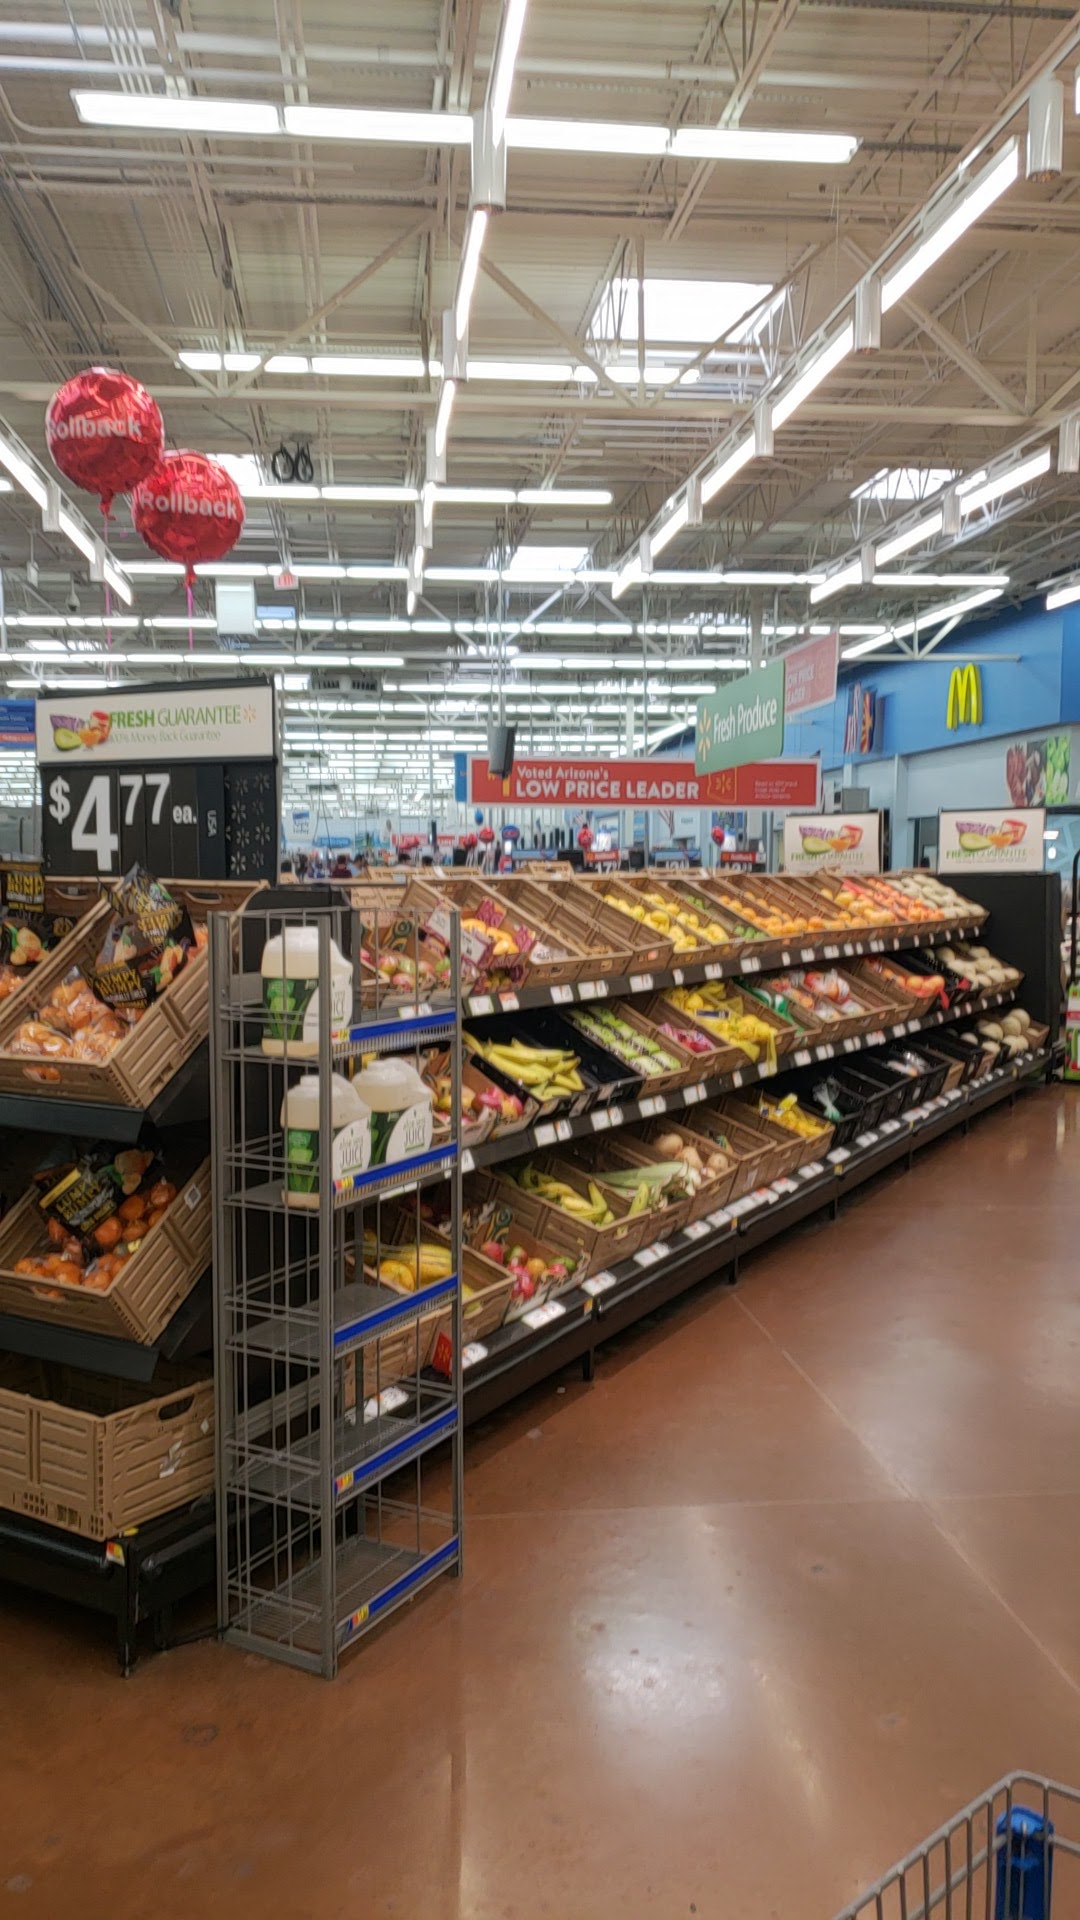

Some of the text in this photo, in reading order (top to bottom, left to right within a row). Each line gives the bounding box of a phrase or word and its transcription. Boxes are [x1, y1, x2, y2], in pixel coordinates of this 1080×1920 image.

[139, 490, 238, 520] Rollback
[109, 704, 241, 729] FRESH GUARANTEE
[713, 694, 778, 744] Fresh Produce
[517, 765, 609, 780] Voted Arizona's
[516, 780, 699, 799] LOW PRICE LEADER
[405, 1125, 425, 1145] JUICE
[341, 1145, 363, 1167] JUICE
